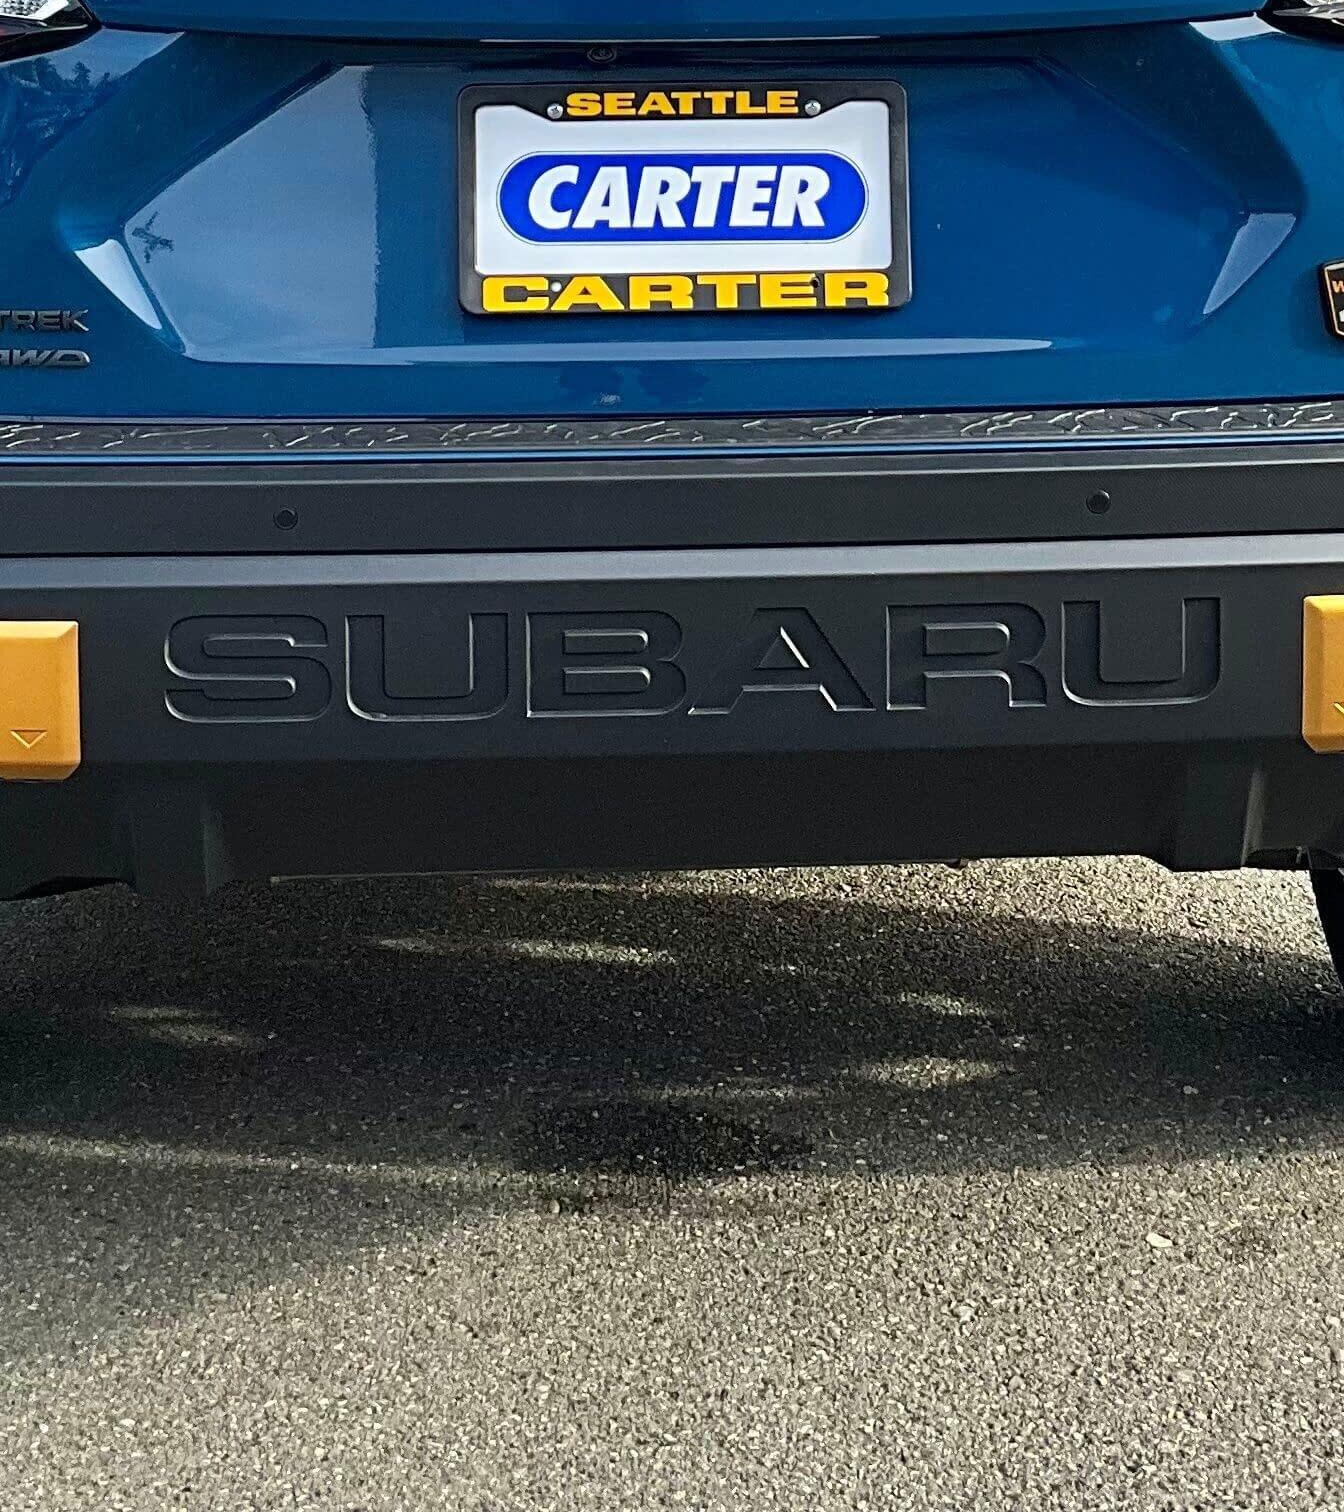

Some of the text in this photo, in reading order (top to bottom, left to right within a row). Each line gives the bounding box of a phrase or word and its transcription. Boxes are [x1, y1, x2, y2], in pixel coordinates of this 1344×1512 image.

[566, 90, 799, 117] SEATTLE
[528, 164, 830, 231] CARTER
[481, 272, 890, 313] CARTER
[164, 596, 1222, 724] SUBARU
